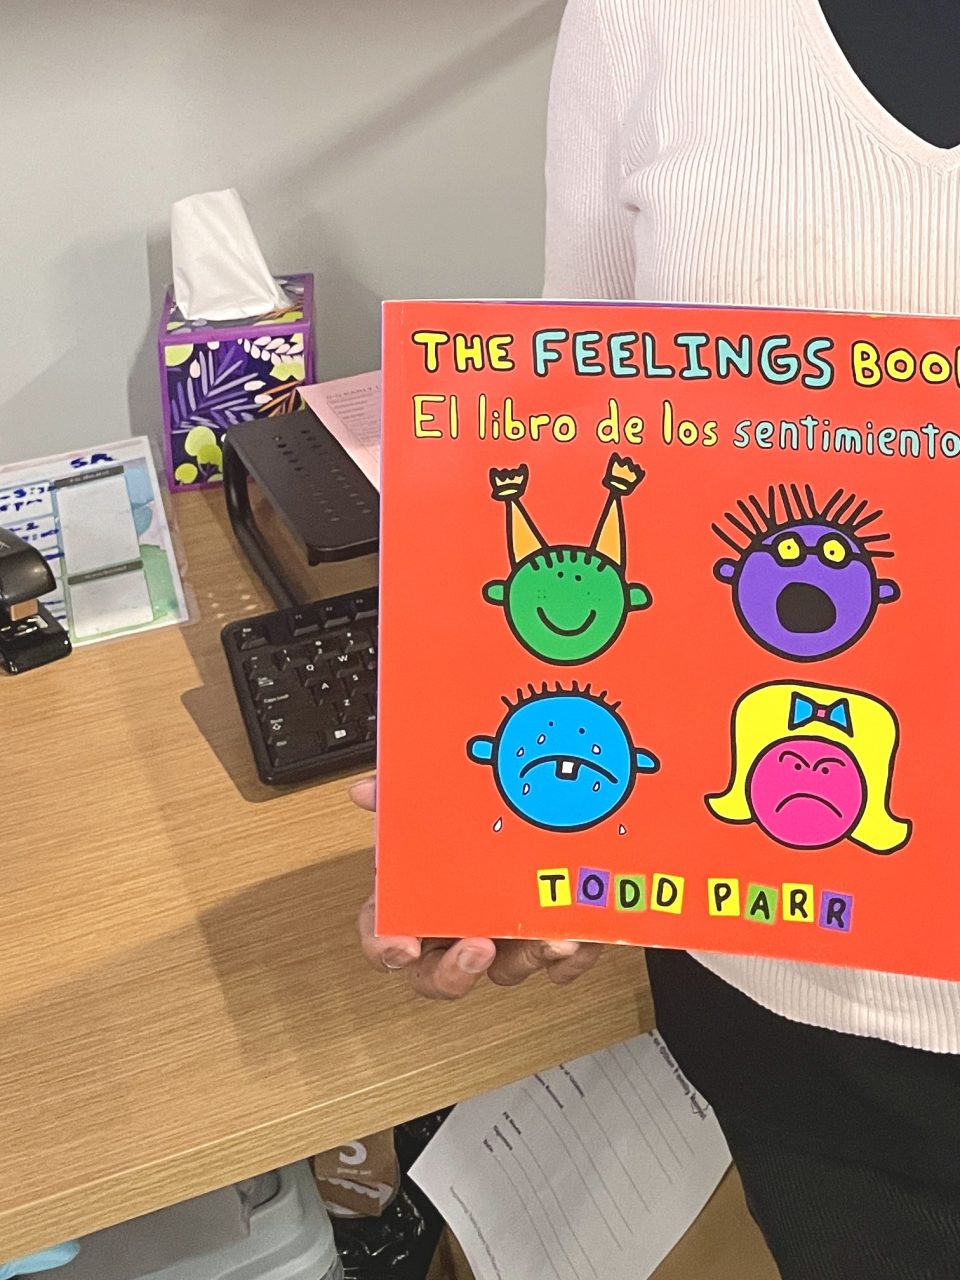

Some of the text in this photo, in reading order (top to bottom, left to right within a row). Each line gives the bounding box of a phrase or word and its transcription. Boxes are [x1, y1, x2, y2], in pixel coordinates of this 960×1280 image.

[412, 329, 513, 374] THE
[532, 330, 835, 389] FEELINGS
[411, 393, 459, 441] El
[477, 393, 578, 445] libro
[596, 398, 645, 446] de
[662, 400, 719, 447] los
[337, 654, 348, 662] W
[321, 682, 330, 690] A
[540, 873, 846, 930] TODD PARR
